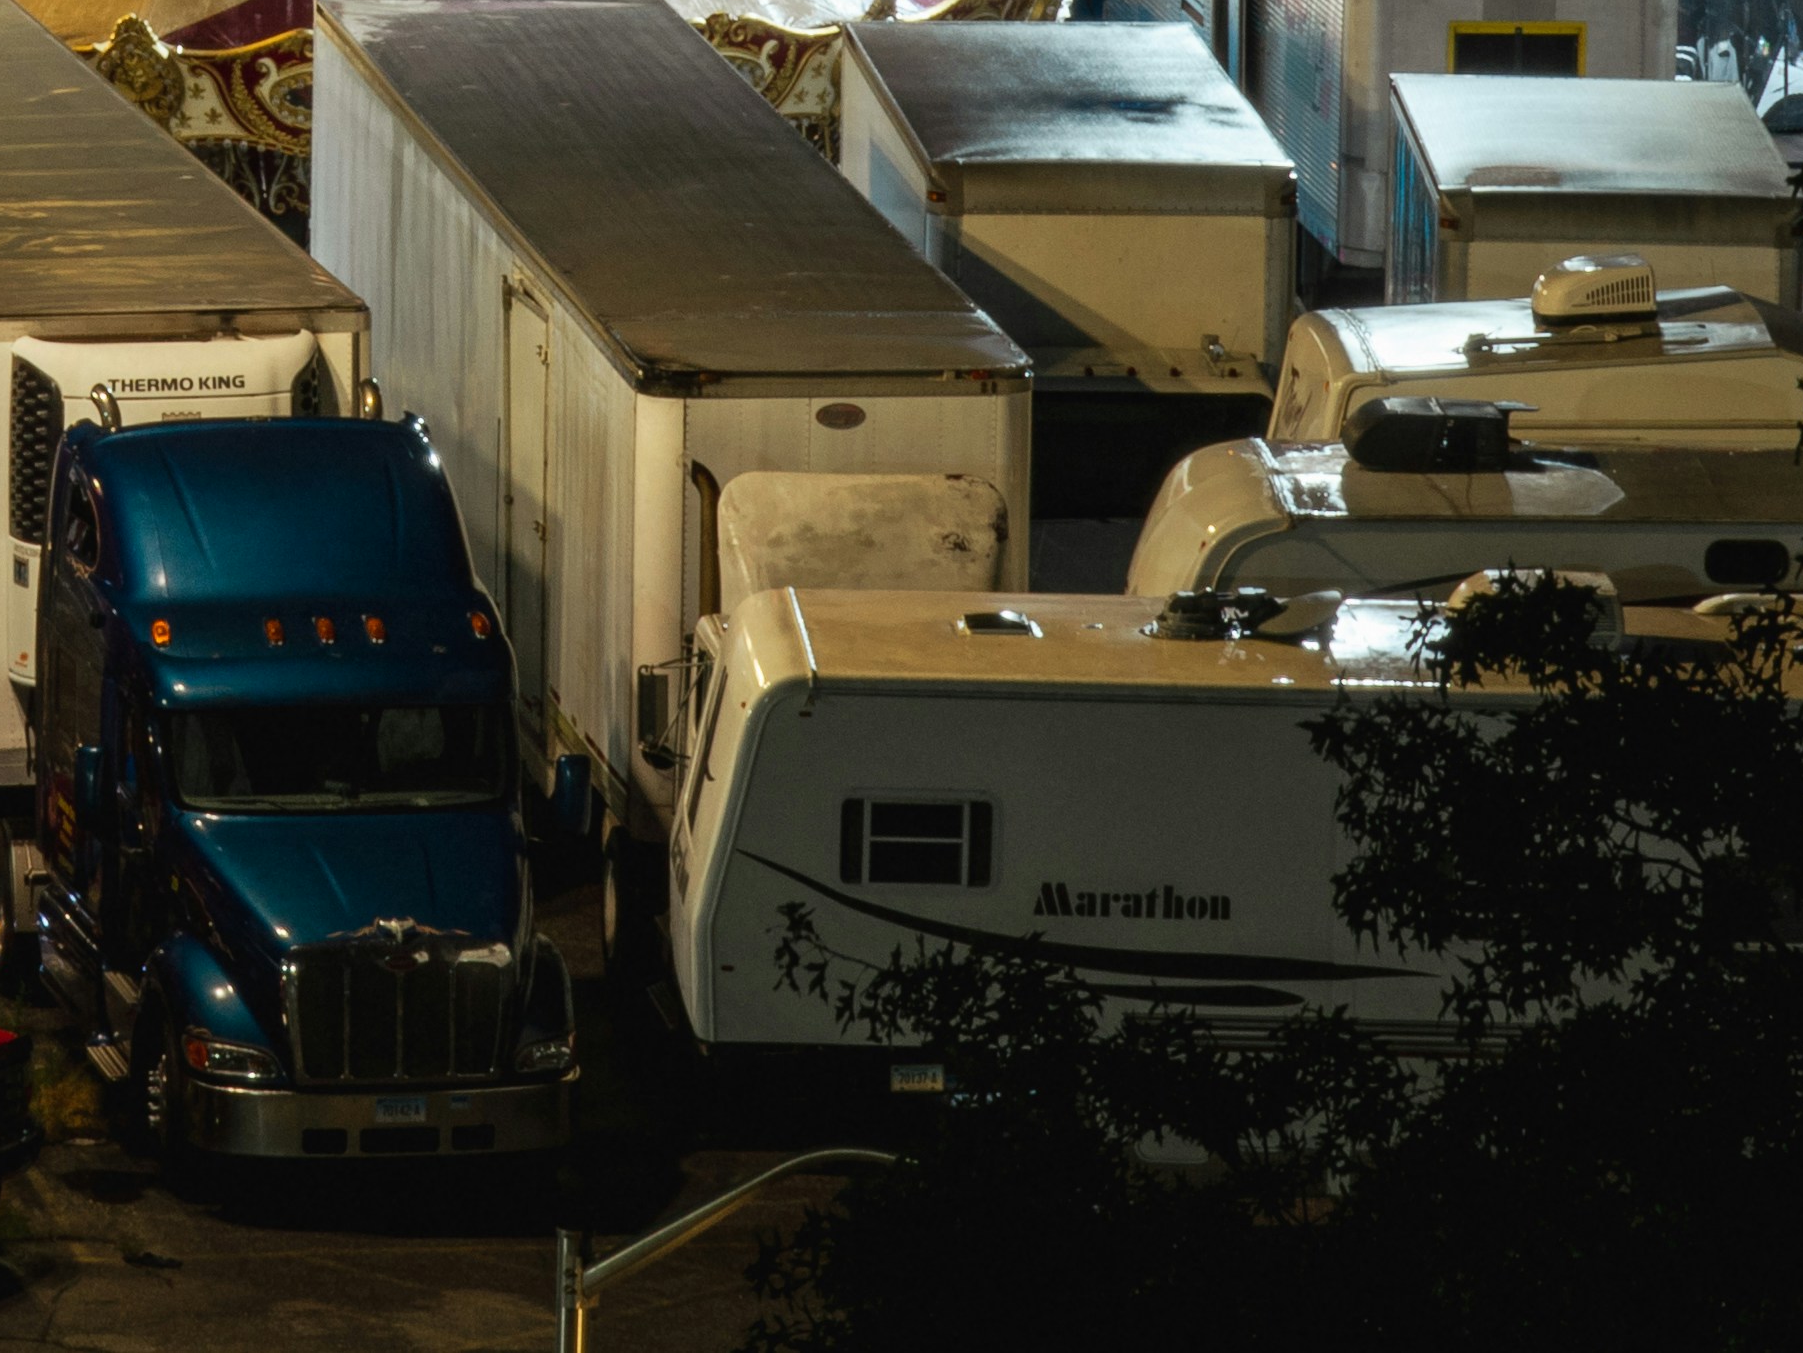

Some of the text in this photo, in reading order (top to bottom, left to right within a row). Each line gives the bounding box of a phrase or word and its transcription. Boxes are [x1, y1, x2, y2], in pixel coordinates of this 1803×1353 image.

[108, 375, 246, 393] THERMO KING
[1034, 882, 1231, 920] Marathon
